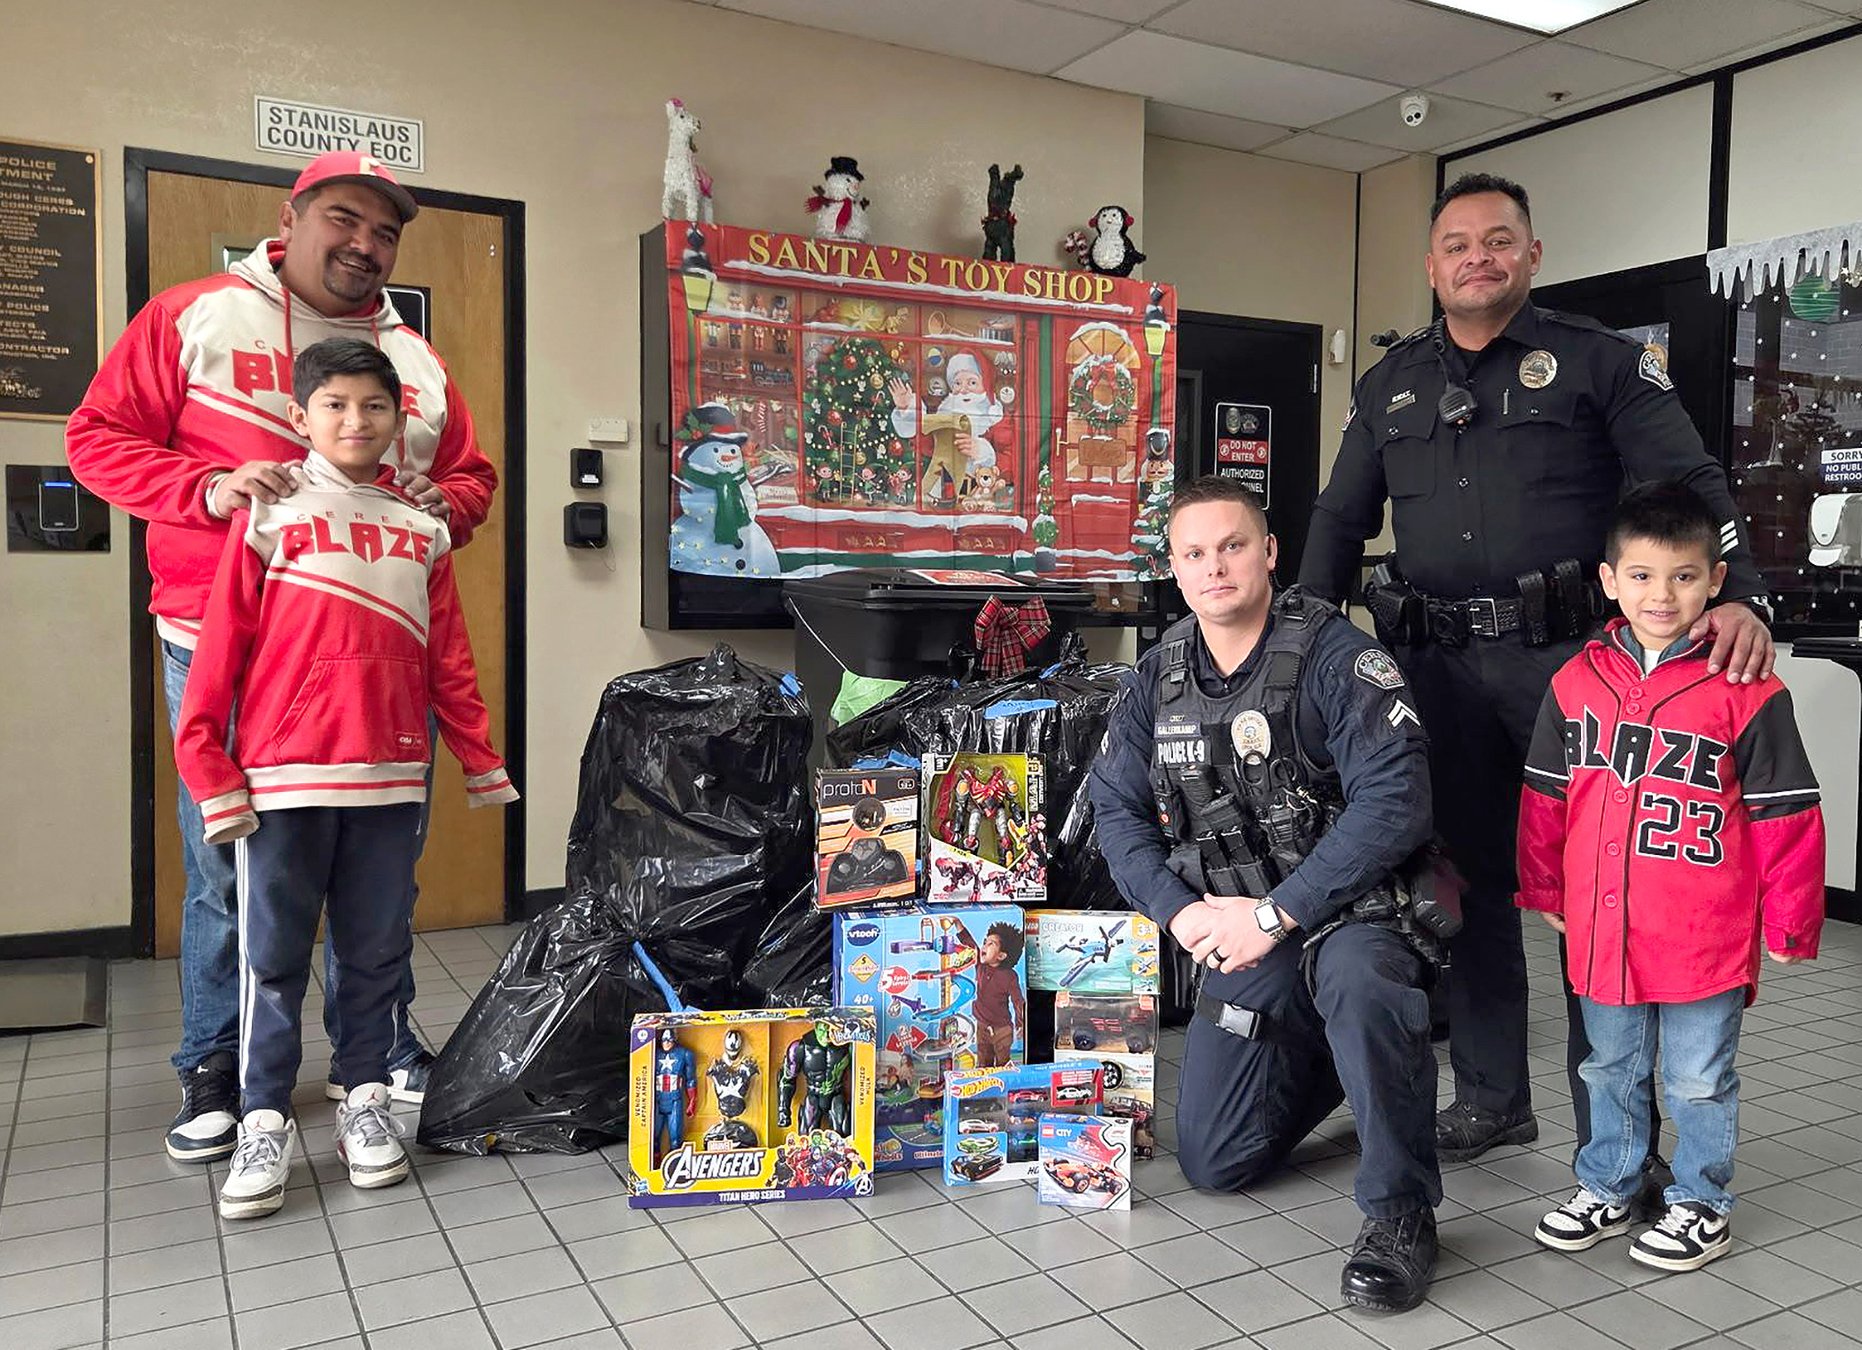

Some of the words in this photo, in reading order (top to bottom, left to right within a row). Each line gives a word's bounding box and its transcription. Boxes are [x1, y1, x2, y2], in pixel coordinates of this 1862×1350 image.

[269, 106, 410, 144] STANISLAUS
[268, 126, 360, 152] COUNTY
[371, 141, 412, 163] EOC
[0, 157, 56, 171] POLICE
[1, 201, 86, 216] CORPORATION
[749, 233, 928, 285] SANTA'S
[941, 258, 1015, 294] TOY
[1024, 269, 1114, 304] SHOP
[1230, 440, 1241, 450] DO
[1241, 441, 1257, 451] NOT
[1231, 452, 1255, 462] ENTER
[1220, 468, 1265, 480] AUTHORIZED
[1826, 464, 1839, 472] NO
[297, 511, 414, 528] CERES
[280, 515, 433, 565] BLAZE
[1157, 741, 1187, 764] POLICE
[1187, 740, 1204, 762] K-9
[1565, 704, 1728, 793] BLAZE
[1636, 791, 1725, 867] 23
[1042, 921, 1084, 932] CREATOR
[878, 969, 894, 992] 5
[1056, 1128, 1073, 1137] CITY
[664, 1144, 767, 1189] AVENGERS
[718, 1191, 741, 1202] TITAN
[740, 1190, 760, 1201] HERO
[760, 1189, 786, 1200] SERIES
